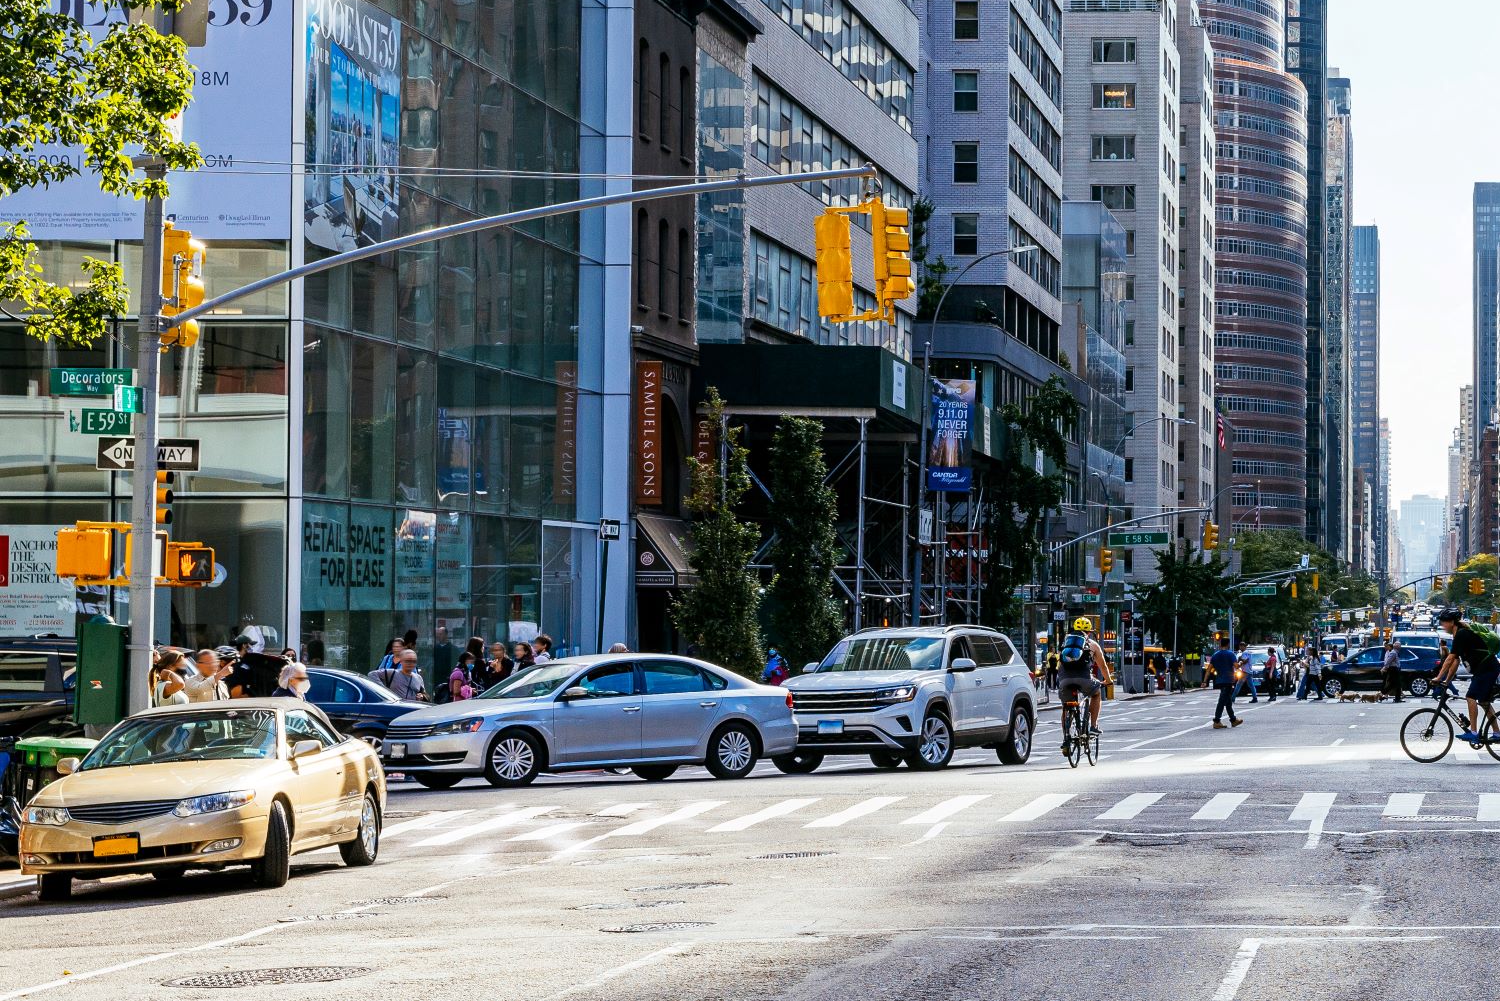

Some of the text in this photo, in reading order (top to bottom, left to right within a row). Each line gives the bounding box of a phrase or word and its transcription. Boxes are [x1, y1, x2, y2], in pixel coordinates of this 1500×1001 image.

[61, 371, 124, 385] Decorators
[87, 385, 99, 393] Way
[948, 401, 968, 409] YEARS
[938, 409, 968, 419] 9.11.01
[87, 411, 127, 431] E 59 St
[937, 420, 967, 430] NEVER
[643, 371, 656, 496] SAMUEL & SONS
[937, 430, 968, 439] FORGET
[113, 447, 186, 461] ON WAY
[304, 522, 346, 553] RETAIL
[350, 524, 386, 555] SPACE
[1125, 534, 1130, 543] E
[1132, 534, 1142, 543] 58
[11, 540, 58, 551] ANCHOR
[11, 551, 35, 562] THE
[11, 562, 51, 573] DESIGN
[320, 557, 385, 588] FOR LEASE
[11, 573, 61, 584] DISTRICT
